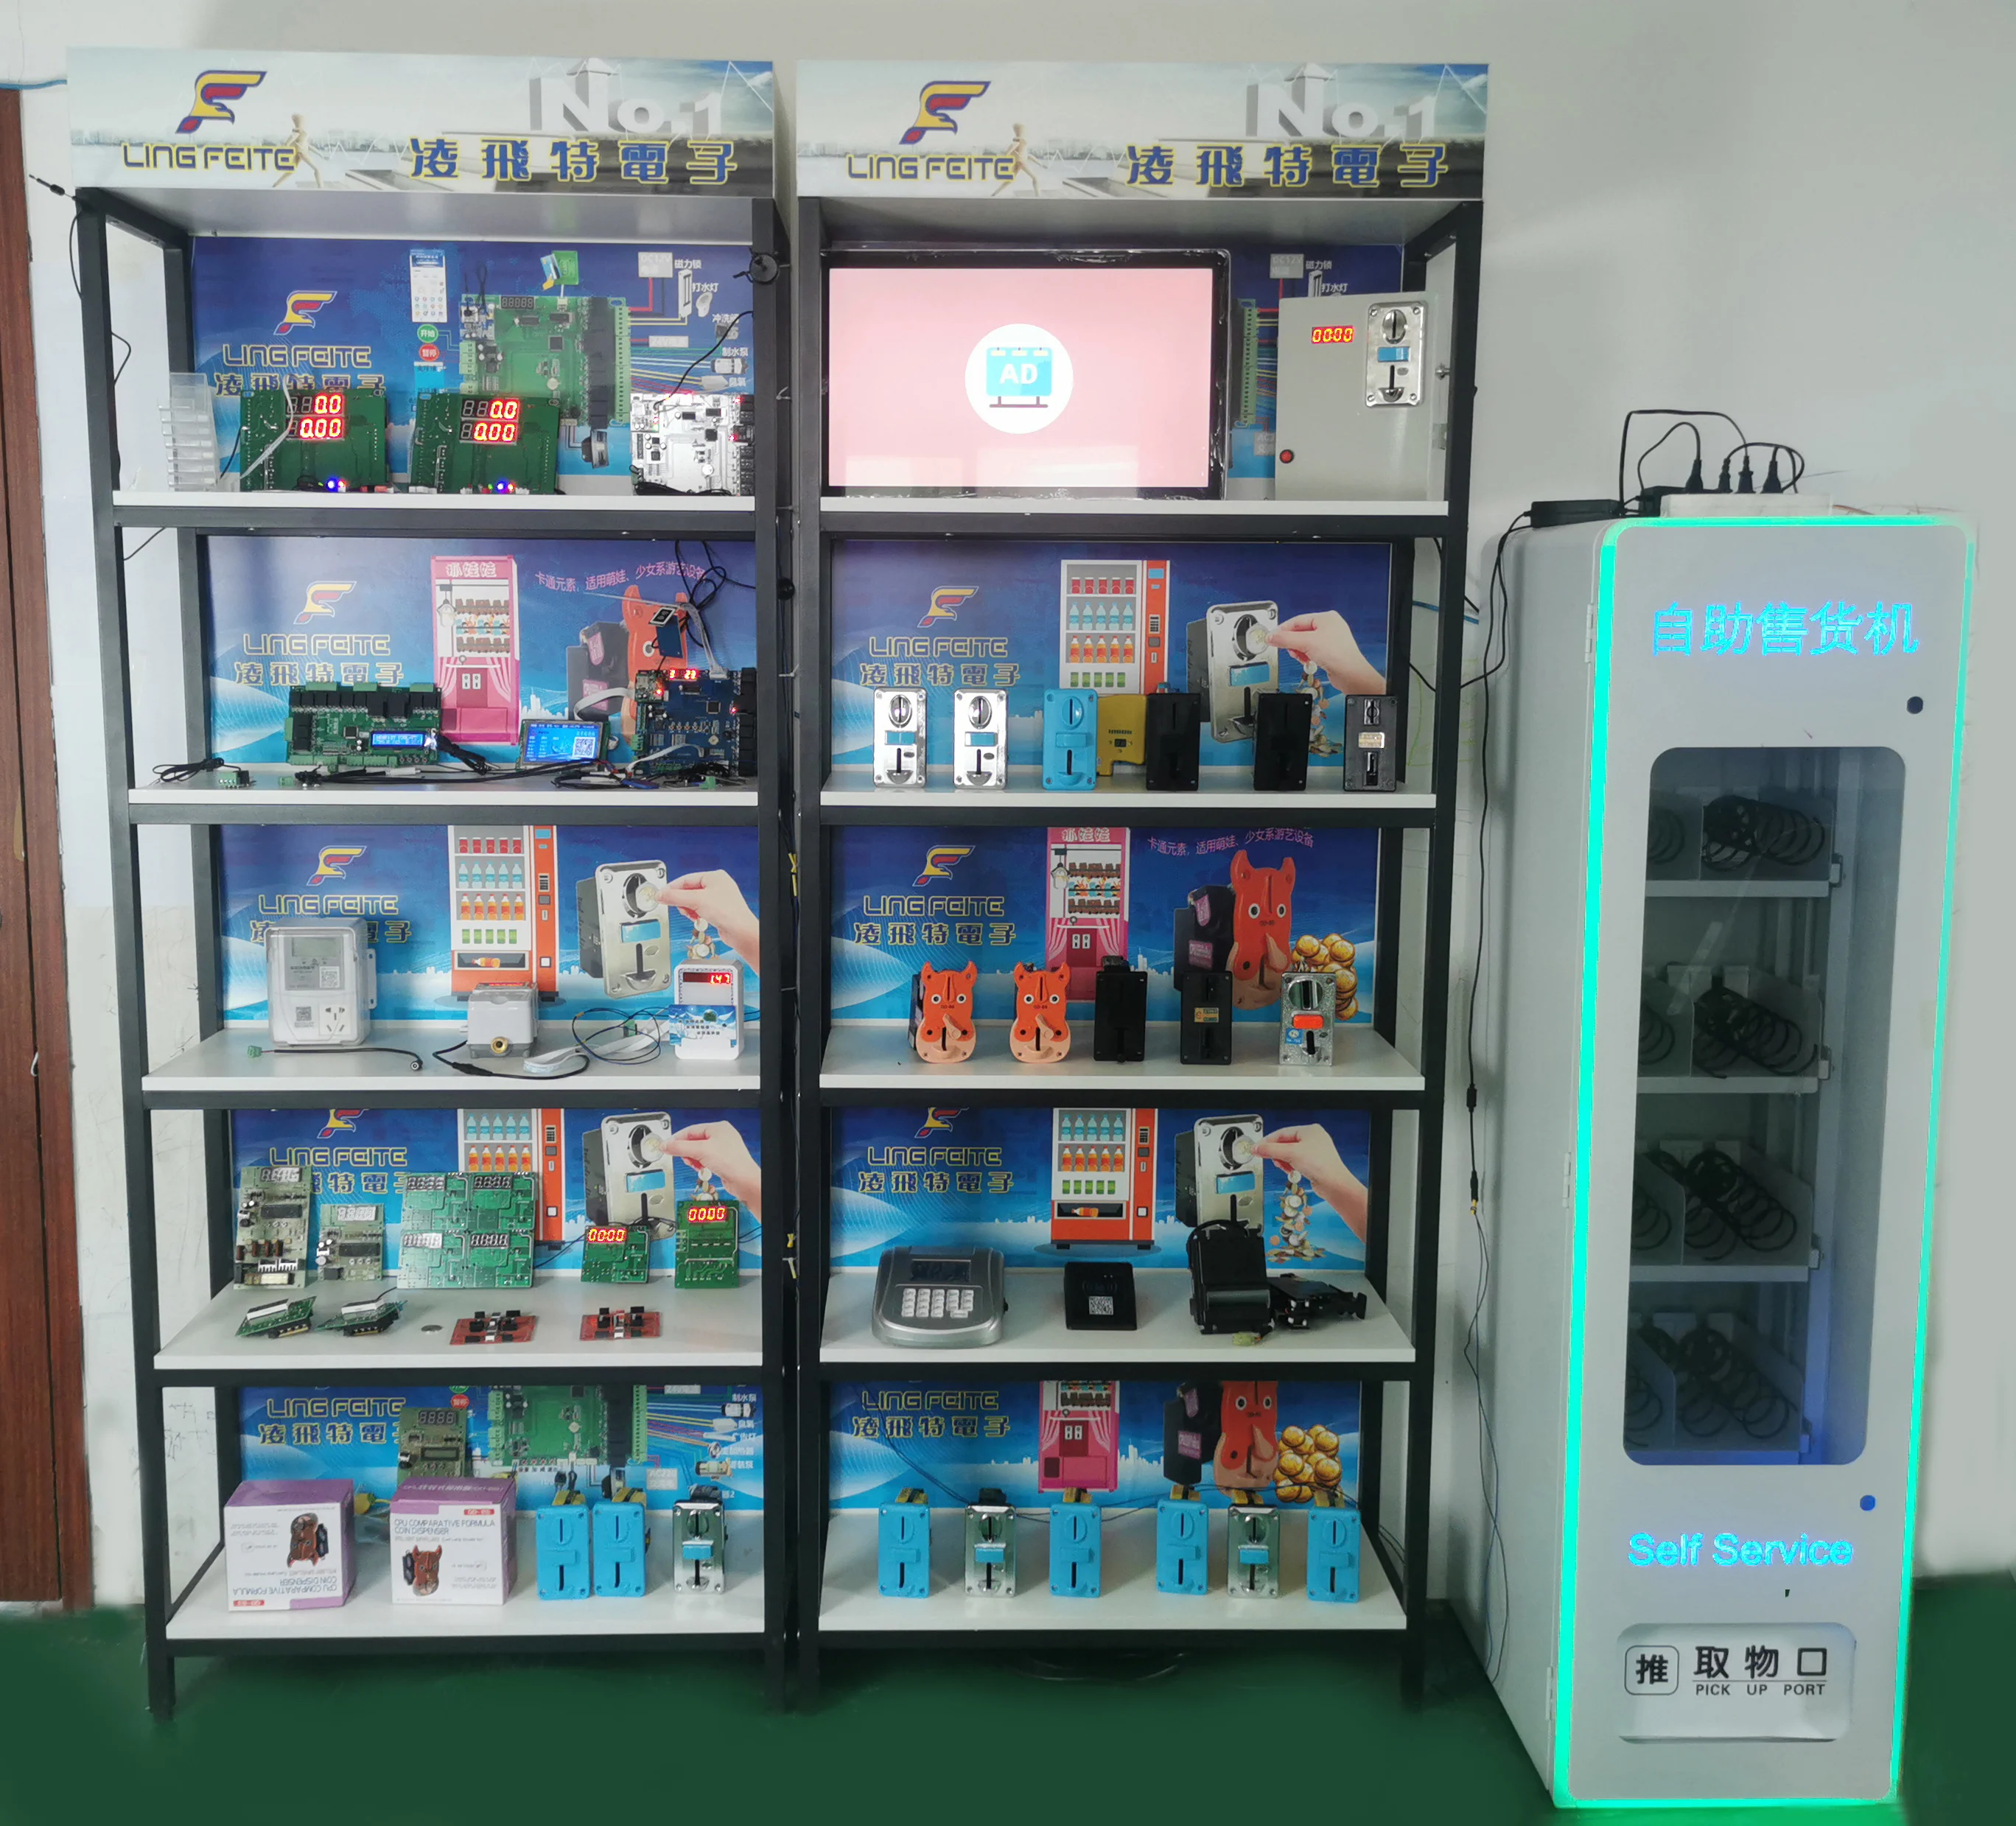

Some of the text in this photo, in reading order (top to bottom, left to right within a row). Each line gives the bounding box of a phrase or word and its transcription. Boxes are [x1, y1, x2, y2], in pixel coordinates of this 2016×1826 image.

[409, 136, 738, 185] 凌飛特電子
[1127, 143, 1449, 189] 凌飛特電子
[999, 363, 1038, 384] AD
[446, 562, 497, 578] 抓娃娃
[1653, 601, 1920, 657] 自助售货机
[1061, 828, 1110, 843] 抓娃娃
[259, 1422, 400, 1445] 凌飛特電
[1628, 1533, 1854, 1567] Self Service
[1636, 1654, 1669, 1685] 推
[1694, 1645, 1827, 1679] 取物口
[1695, 1684, 1826, 1696] PICK UP PORT
